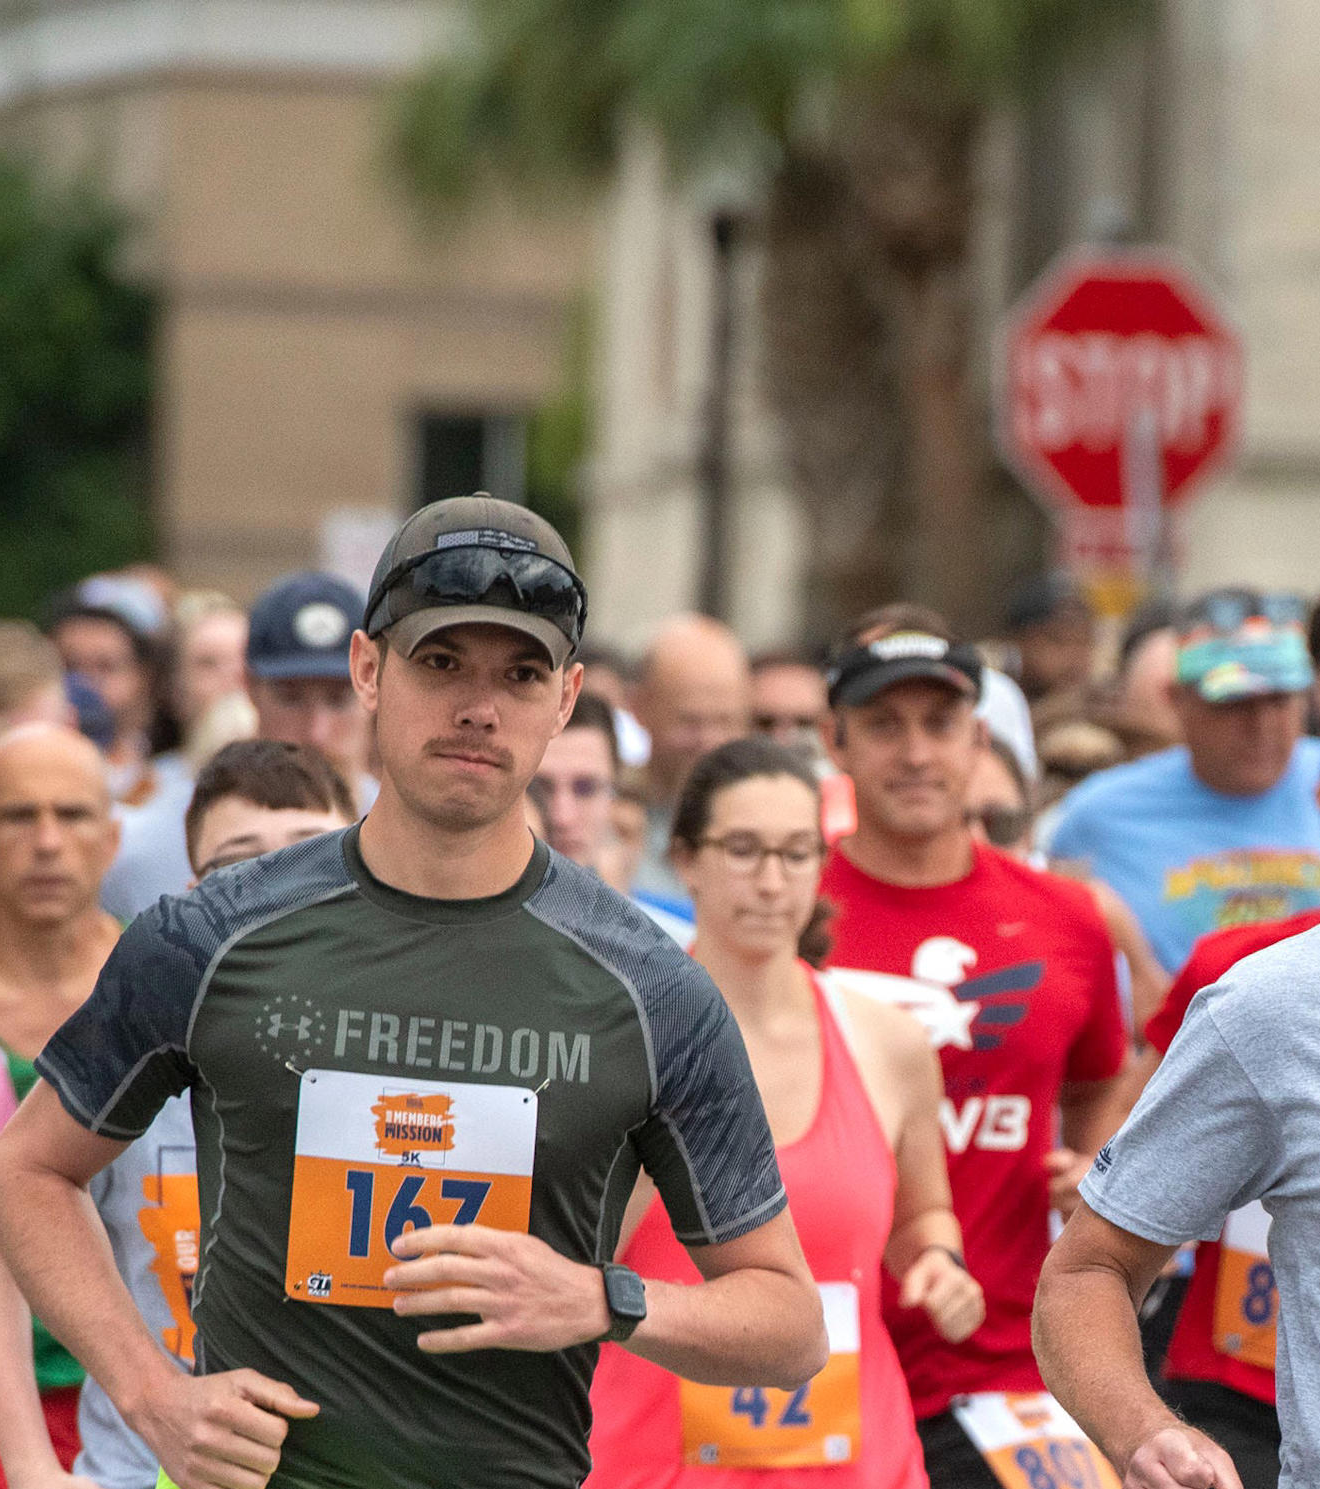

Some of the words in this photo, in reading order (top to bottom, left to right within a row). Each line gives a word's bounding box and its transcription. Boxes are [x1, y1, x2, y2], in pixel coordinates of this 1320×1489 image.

[1013, 336, 1227, 449] STOP
[334, 1009, 591, 1084] FREEDOM
[384, 1122, 442, 1143] MISSION
[393, 1111, 443, 1128] MEMBERS
[401, 1151, 421, 1163] 5K
[346, 1169, 492, 1262] 167
[731, 1384, 812, 1428] 42
